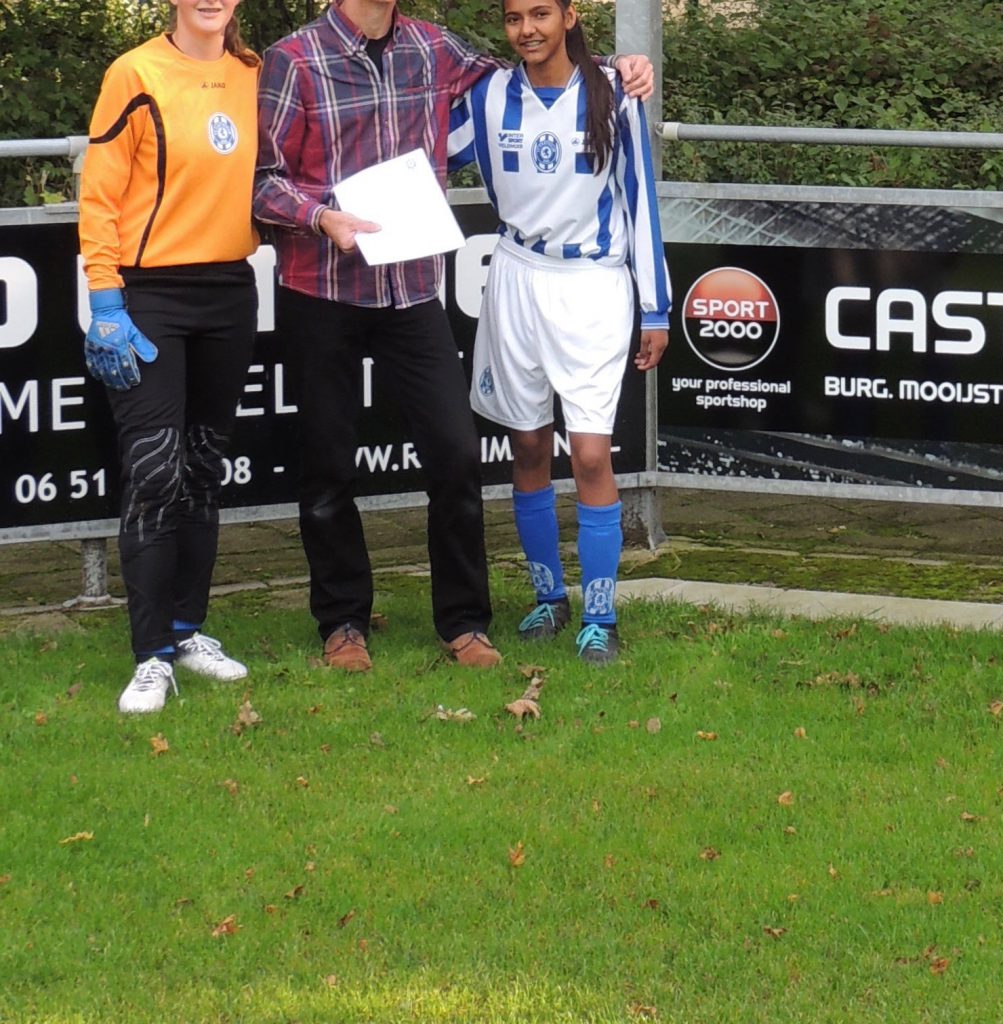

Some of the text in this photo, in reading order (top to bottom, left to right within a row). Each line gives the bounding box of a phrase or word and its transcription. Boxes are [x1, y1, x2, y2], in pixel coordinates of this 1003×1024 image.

[692, 298, 769, 318] SPORT
[699, 319, 763, 340] 2000
[672, 377, 791, 394] your professional
[824, 376, 894, 399] BURG.
[695, 394, 767, 413] sportshop
[15, 472, 57, 504] 06
[70, 468, 106, 499] 51
